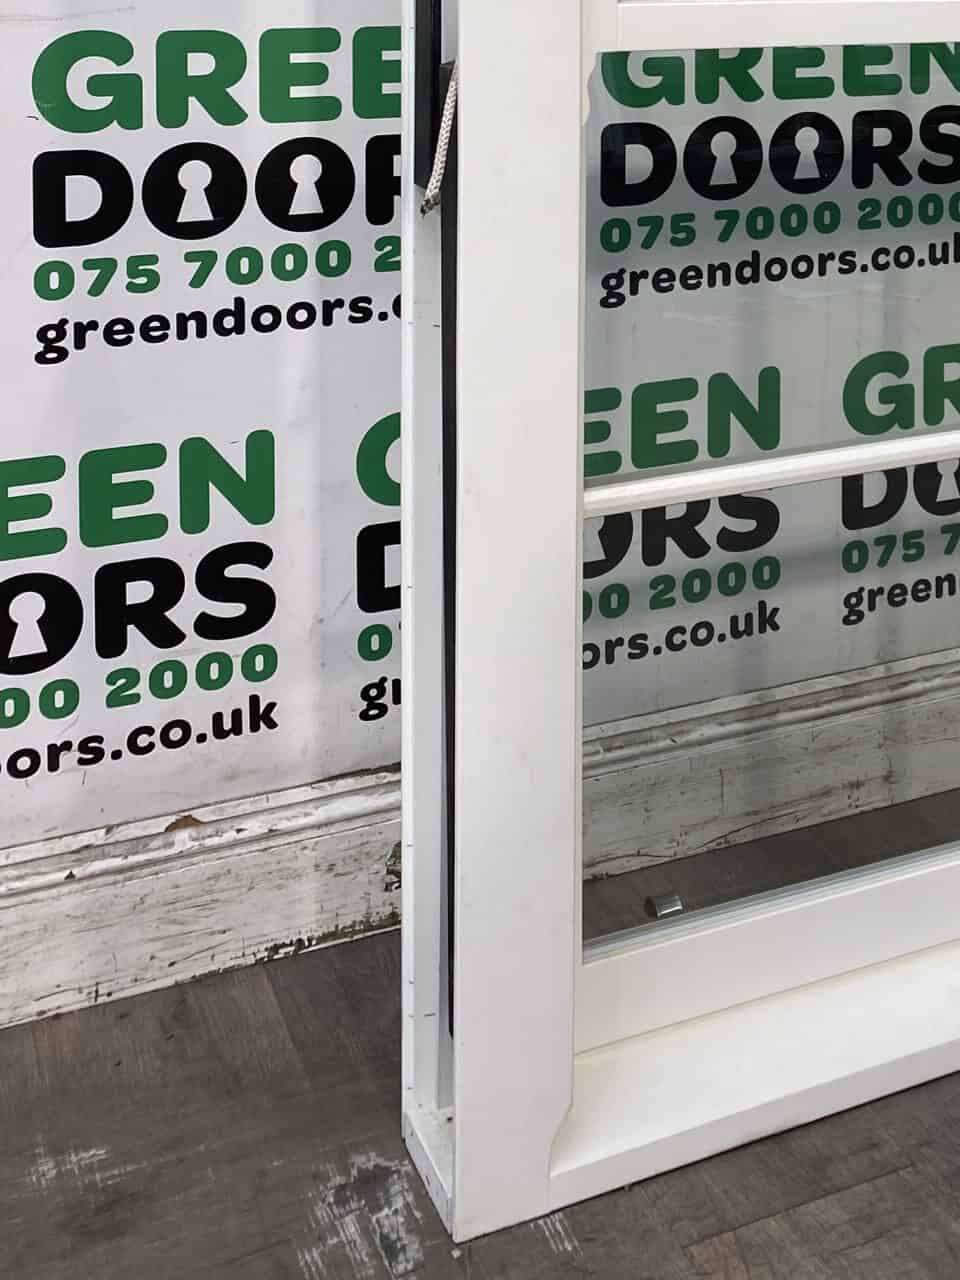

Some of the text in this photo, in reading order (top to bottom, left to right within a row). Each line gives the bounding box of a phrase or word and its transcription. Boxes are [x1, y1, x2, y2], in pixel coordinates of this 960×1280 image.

[600, 212, 696, 253] 075
[714, 200, 841, 242] 7000
[33, 254, 160, 301] 075
[184, 240, 352, 289] 7000
[34, 294, 401, 364] greendoors.
[842, 529, 924, 574] 075
[649, 556, 781, 610] 2000
[105, 643, 278, 708] 2000
